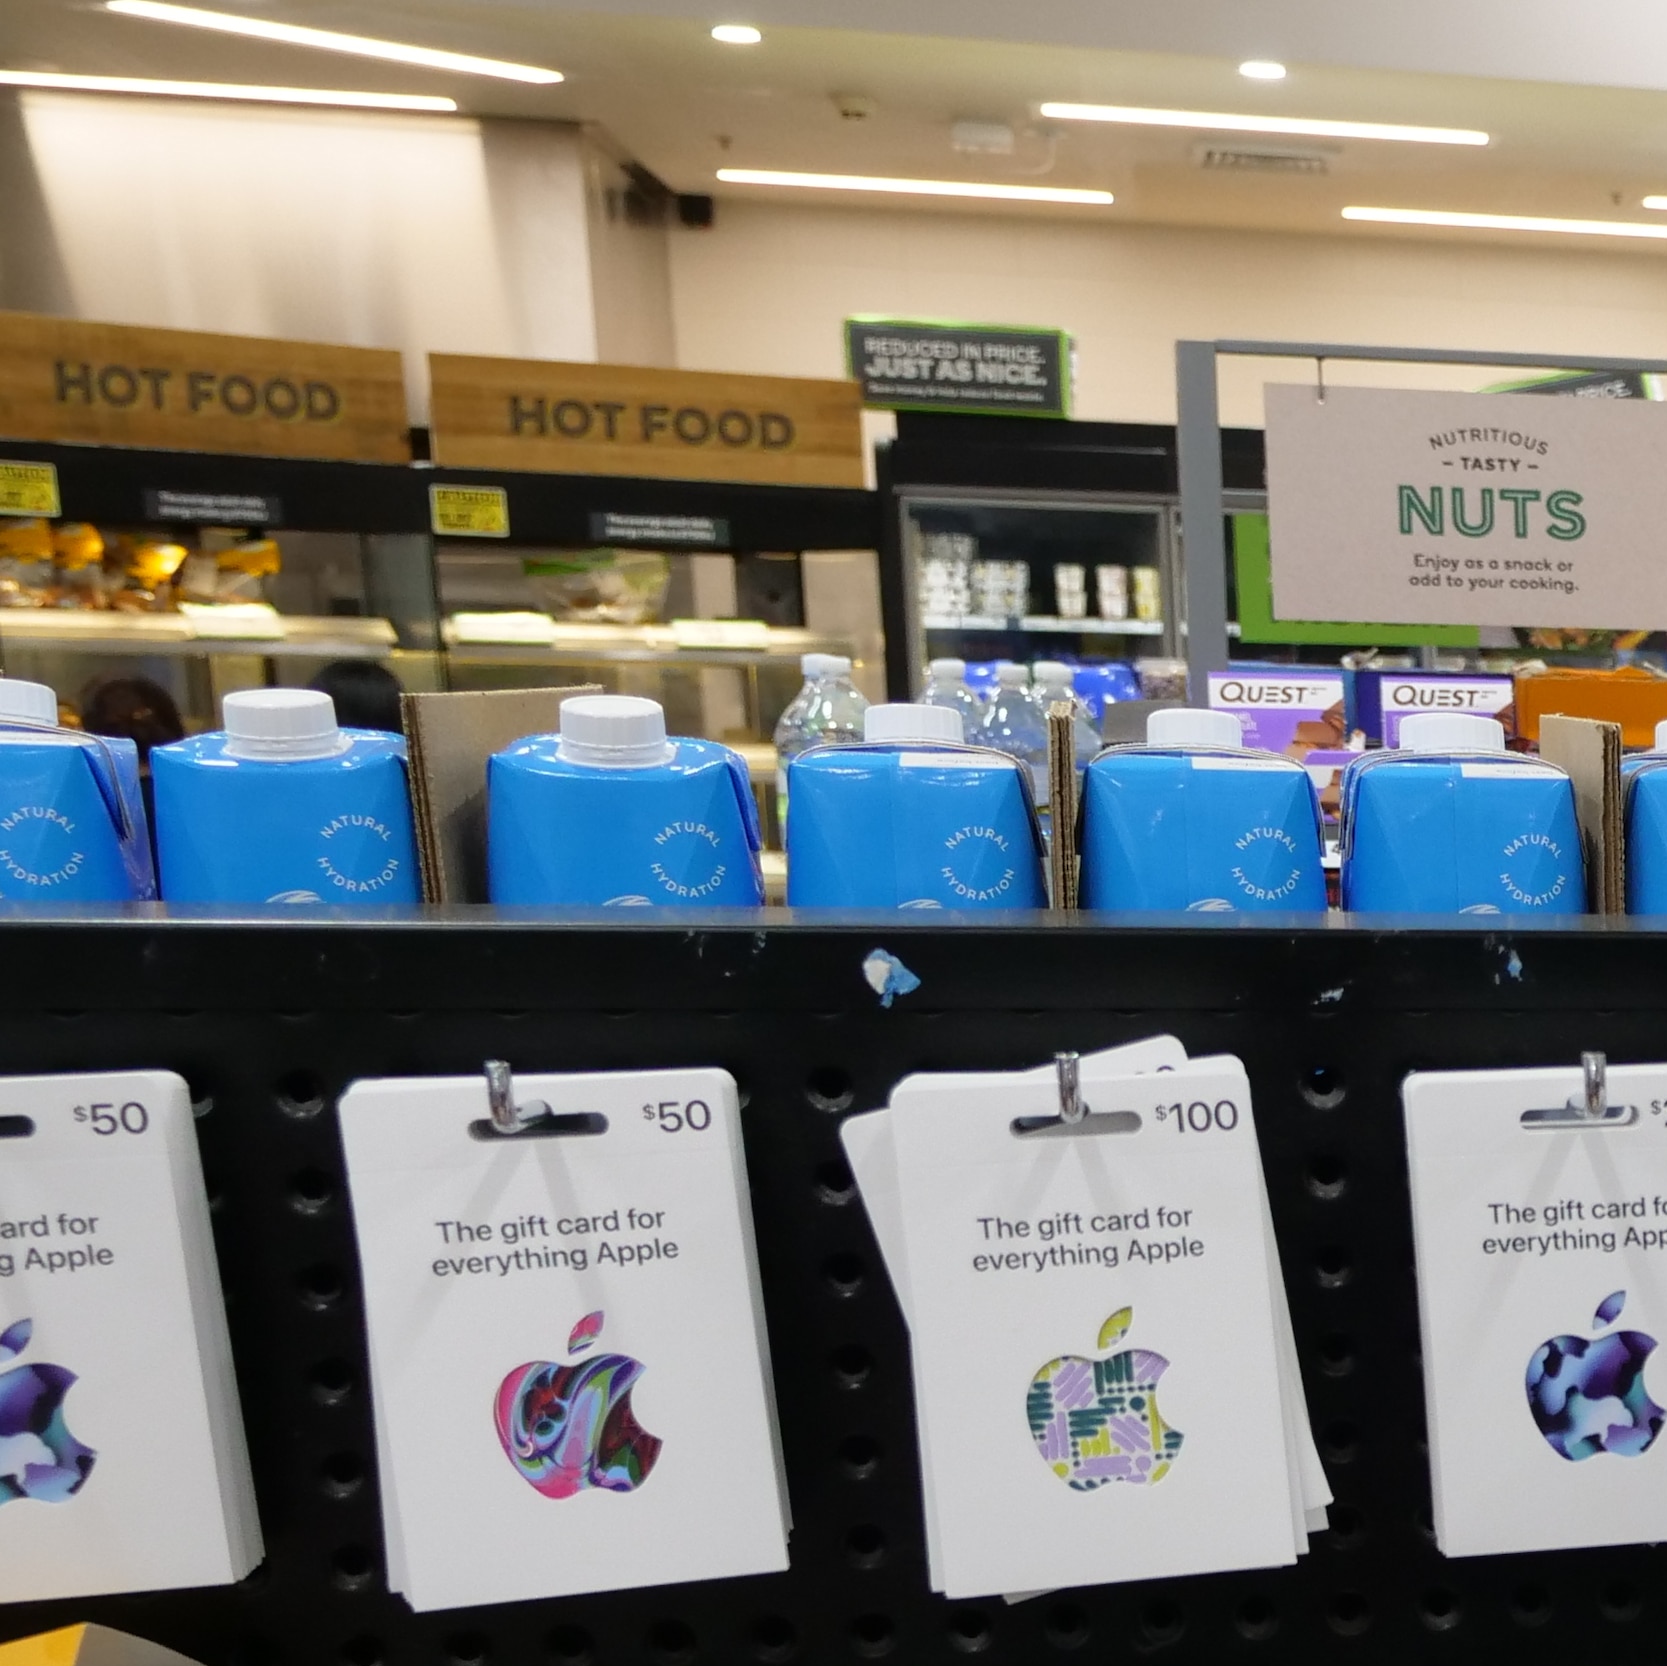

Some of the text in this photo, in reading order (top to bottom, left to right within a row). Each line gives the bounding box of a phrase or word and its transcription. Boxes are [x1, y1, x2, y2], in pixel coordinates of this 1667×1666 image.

[864, 337, 1046, 365] REDUCED IN PRICE.
[865, 357, 1047, 386] JUST AS NICE.
[54, 359, 342, 423] HOT FOOD
[508, 395, 797, 451] HOT FOOD
[1429, 428, 1549, 455] NUTRITIOUS
[1461, 457, 1521, 471] TASTY
[1398, 485, 1586, 541] NUTS
[1414, 554, 1573, 571] Enjoy as a snack or
[1409, 575, 1579, 594] add to your cooking.
[1219, 678, 1308, 706] QUEST
[654, 821, 722, 849] NATURAL
[650, 863, 727, 898] HYDRATION
[1488, 1203, 1536, 1224] The
[1543, 1200, 1584, 1227] gift
[1591, 1198, 1646, 1219] card
[1482, 1229, 1616, 1255] everything
